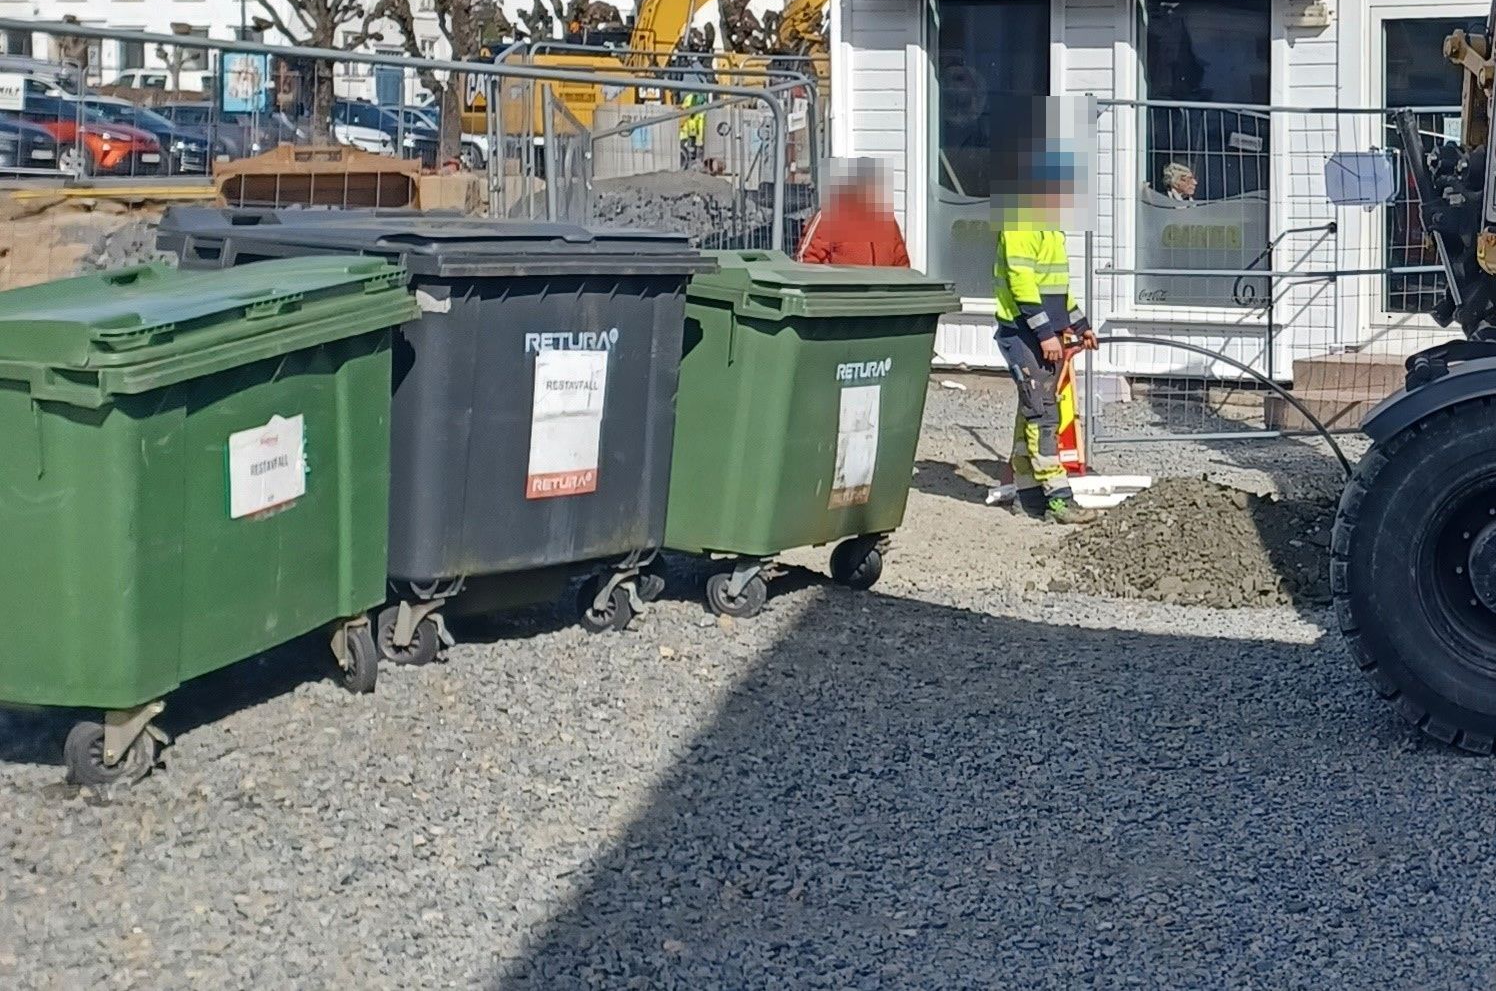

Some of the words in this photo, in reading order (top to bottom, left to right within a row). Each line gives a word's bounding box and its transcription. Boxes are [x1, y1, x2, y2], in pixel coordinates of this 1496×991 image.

[525, 331, 611, 353] RETURA
[836, 361, 885, 381] RETURA
[532, 476, 587, 493] RETURA
